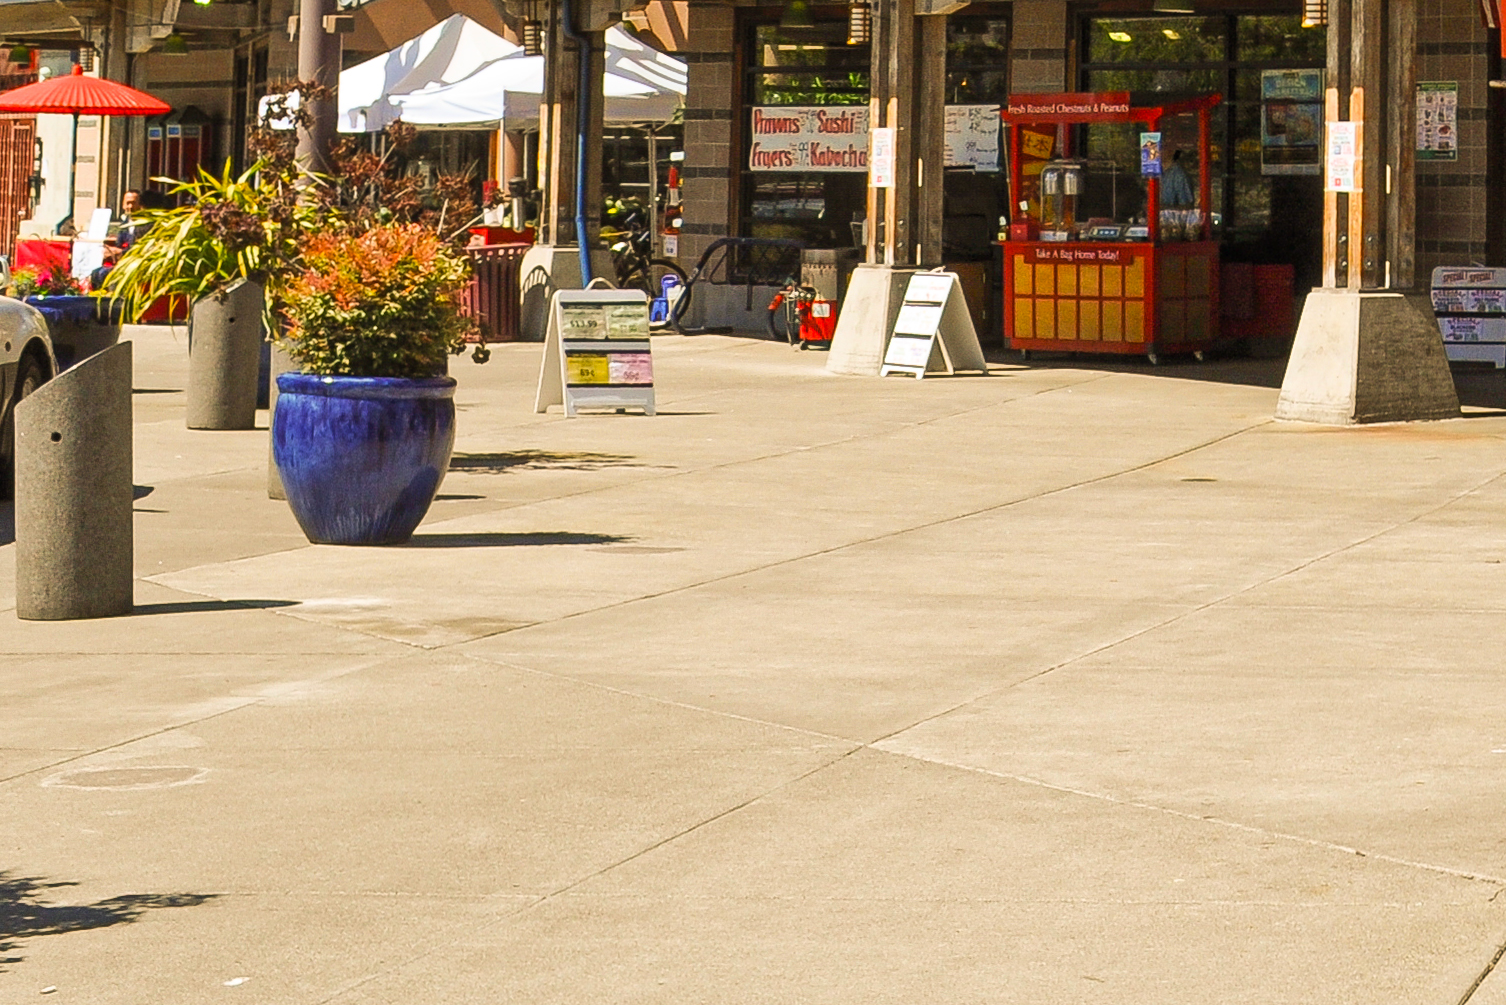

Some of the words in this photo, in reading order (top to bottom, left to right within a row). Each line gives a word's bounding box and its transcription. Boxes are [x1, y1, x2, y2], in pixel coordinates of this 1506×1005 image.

[1008, 104, 1026, 115] Fresh
[1027, 103, 1055, 114] Roasted
[1057, 103, 1091, 113] Chestnuts
[1093, 103, 1098, 113] &
[1101, 102, 1129, 113] Peanuts
[817, 109, 856, 134] Sushi
[1035, 248, 1051, 259] Take
[1052, 249, 1058, 259] A
[1060, 249, 1074, 261] Bag
[1075, 249, 1096, 259] Home
[1097, 249, 1120, 261] Today!
